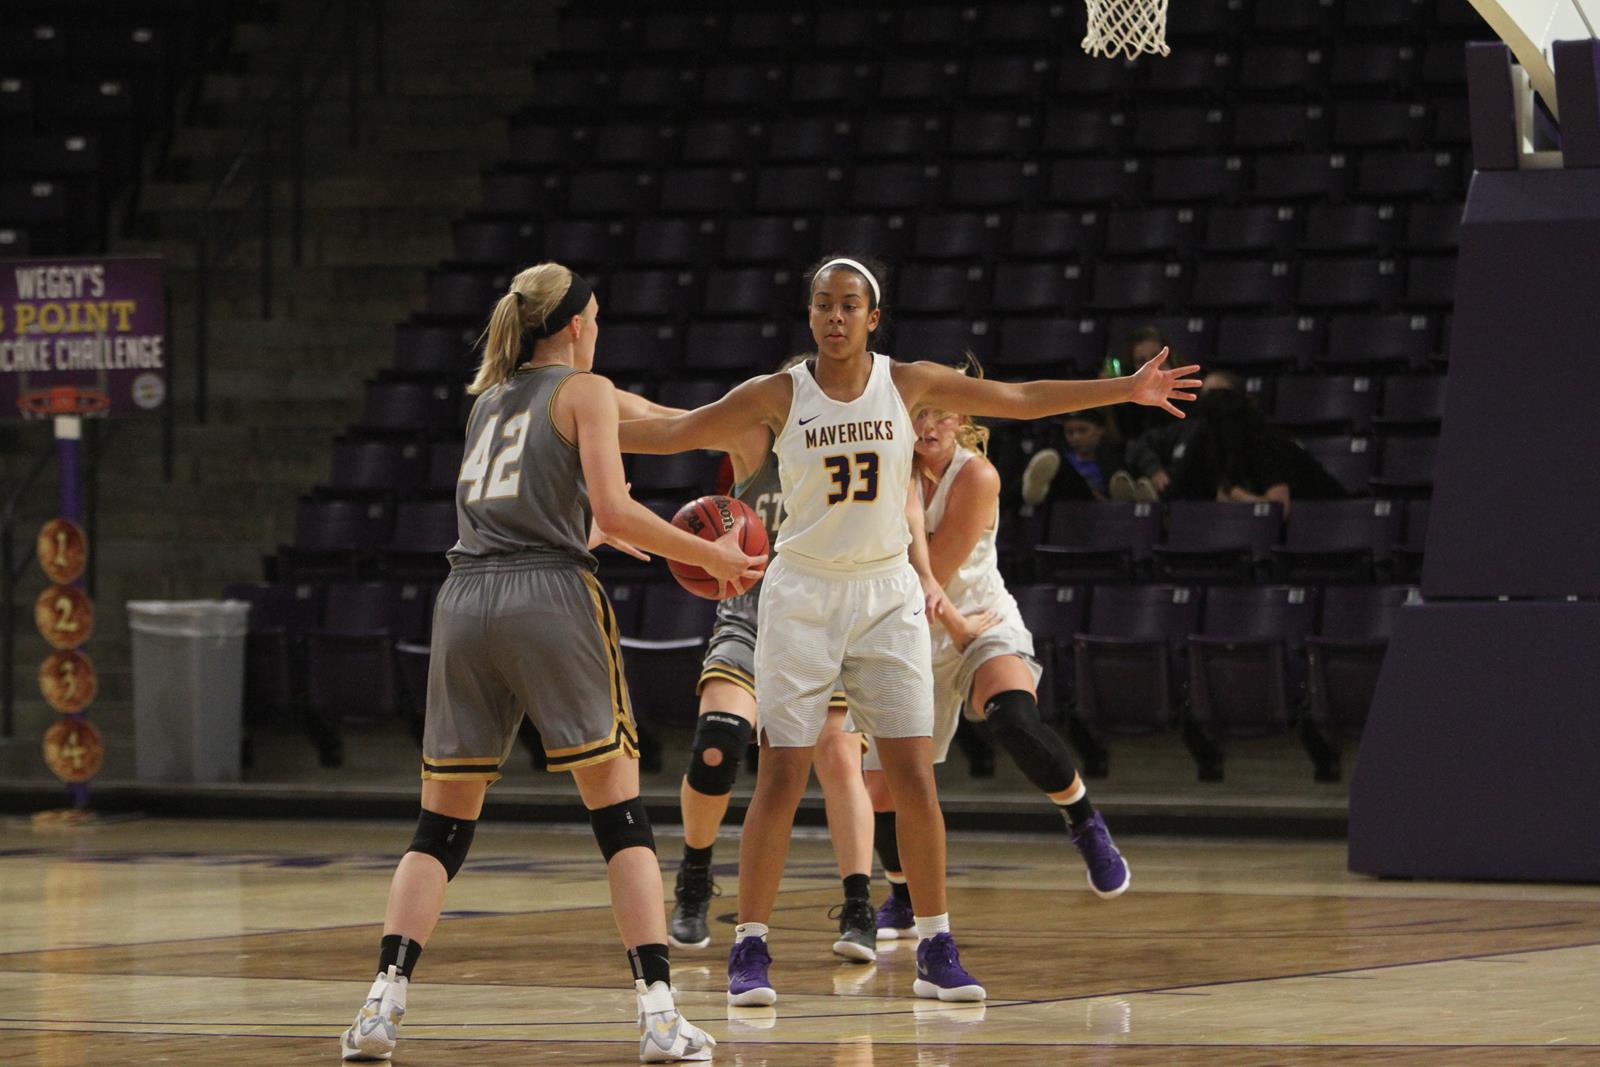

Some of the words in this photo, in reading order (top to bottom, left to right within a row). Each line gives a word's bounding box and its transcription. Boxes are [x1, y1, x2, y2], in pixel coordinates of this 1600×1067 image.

[16, 265, 105, 300] WEGGY'S
[15, 301, 136, 335] POINT
[55, 335, 164, 371] CHALLENGE
[805, 420, 894, 449] MAVERICKS
[460, 410, 531, 504] 42
[823, 451, 880, 506] 33
[54, 531, 67, 566] 1
[54, 598, 78, 632] 2
[60, 660, 77, 700] 3
[60, 731, 88, 769] 4
